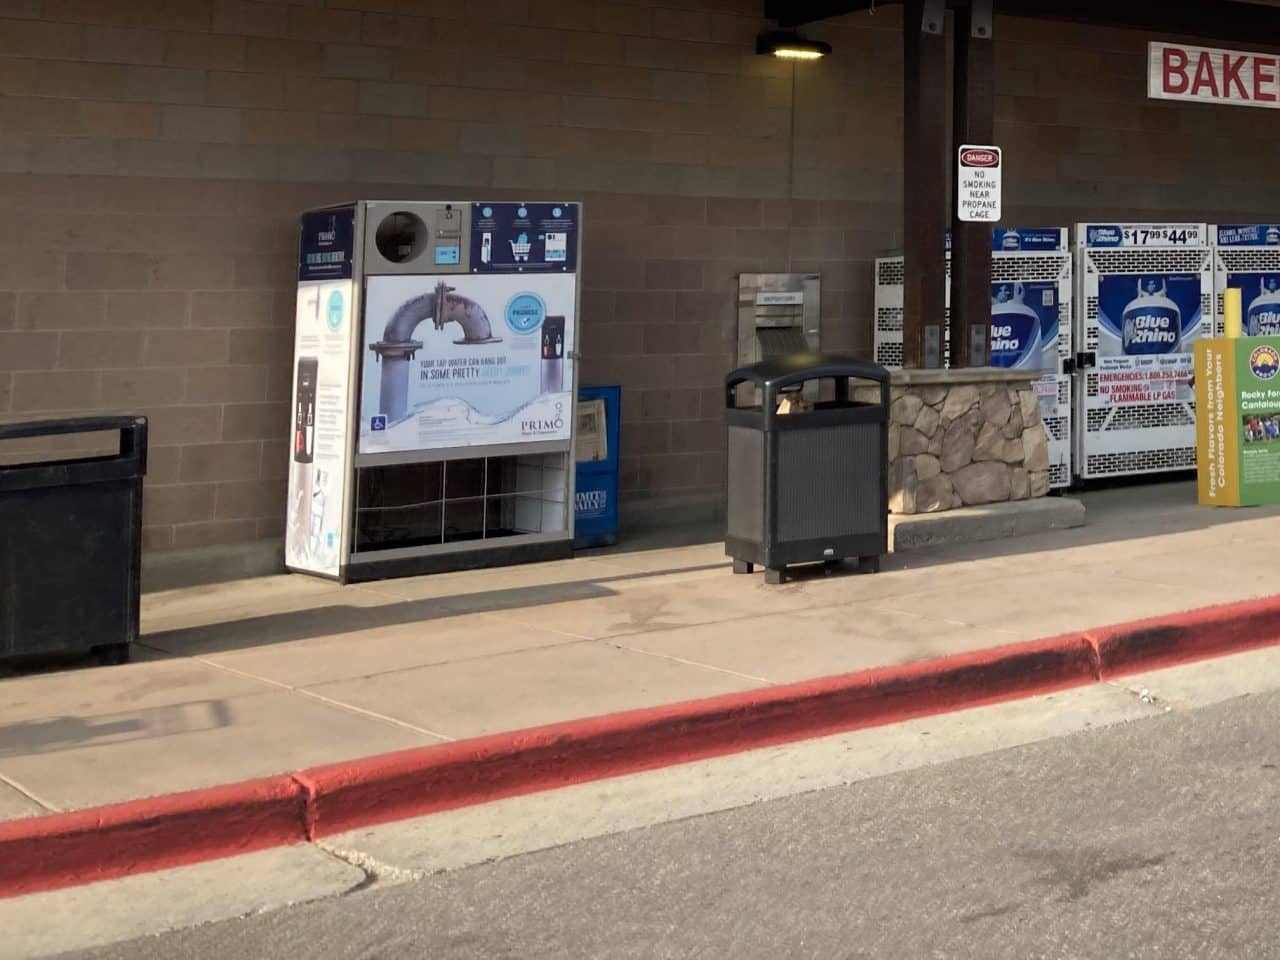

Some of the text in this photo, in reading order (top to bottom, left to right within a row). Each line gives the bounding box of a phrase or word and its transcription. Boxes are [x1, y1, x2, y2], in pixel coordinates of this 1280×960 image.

[966, 154, 993, 162] DANGER
[963, 181, 996, 189] SMOKING
[962, 200, 997, 209] PROPANE
[1135, 316, 1170, 328] Blue
[991, 324, 1012, 337] lue
[992, 338, 1019, 350] ino
[420, 370, 429, 380] IN
[430, 369, 449, 380] SOME
[452, 367, 480, 379] PRETTY
[1100, 384, 1143, 394] NO SMOKING
[1110, 391, 1176, 403] FLAMMABLE LP GAS
[1241, 391, 1266, 401] Rocky
[521, 418, 564, 431] PRIMO
[1216, 354, 1225, 488] Colorado Neighbors
[1208, 463, 1216, 497] Fresh
